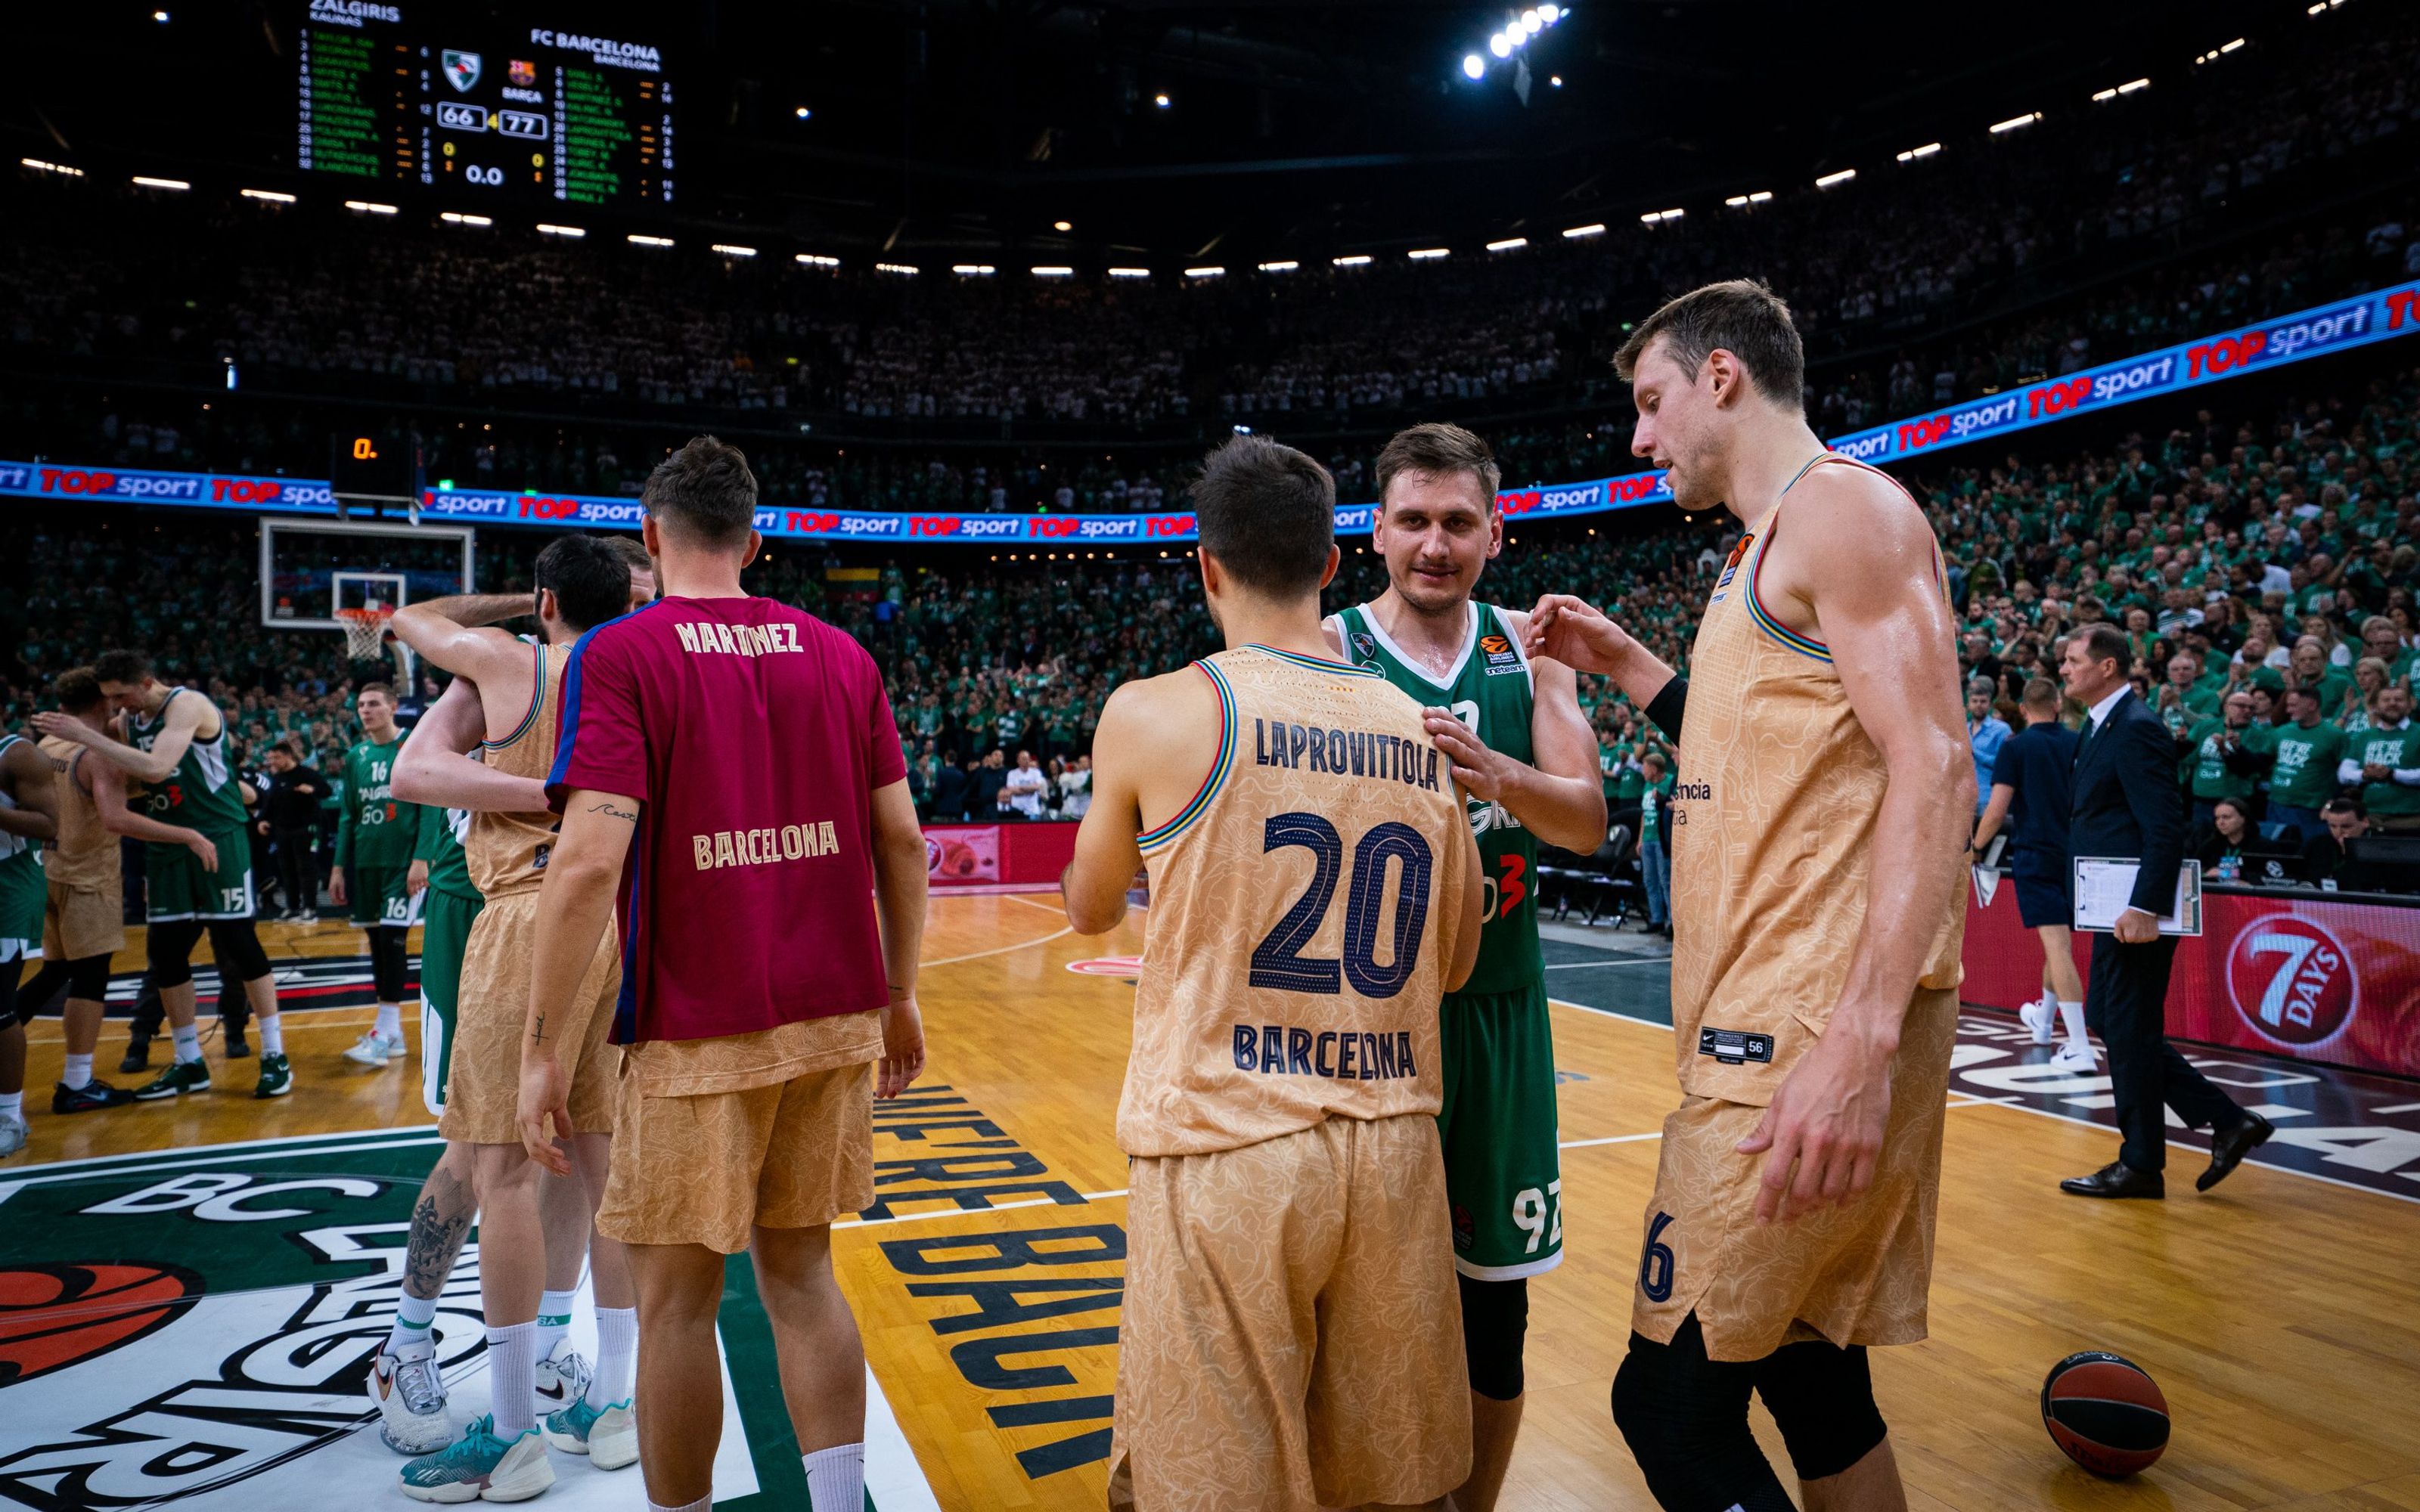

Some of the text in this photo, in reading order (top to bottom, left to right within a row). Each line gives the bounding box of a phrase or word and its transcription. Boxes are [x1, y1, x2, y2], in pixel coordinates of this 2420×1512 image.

[531, 29, 661, 62] FC BARCELONA
[442, 106, 474, 126] 66
[505, 114, 535, 134] 77
[465, 164, 504, 185] 0.0
[2186, 330, 2267, 381] TOP
[2267, 303, 2369, 355] sport
[2027, 356, 2173, 420] TOP sport
[1897, 398, 2018, 453] TOP sport
[40, 468, 116, 496] TOP
[116, 477, 198, 500] sport
[211, 478, 337, 507] TOP spo
[1541, 485, 1600, 512] sport
[1607, 474, 1657, 505] TOP
[435, 494, 507, 515] sport
[517, 496, 646, 522] TOP sport
[1333, 509, 1368, 528] ort
[785, 511, 840, 534] TOP
[840, 516, 901, 536] sport
[908, 516, 1020, 538] TOP sport
[1028, 516, 1137, 539] TOP sport
[1145, 516, 1196, 538] TOP
[674, 622, 805, 658] MARTINEZ
[1255, 718, 1440, 793] LAPROVITTOLA
[371, 761, 388, 782] 16
[692, 820, 840, 871] BARCELONA
[221, 887, 244, 912] 15
[386, 897, 407, 919] 16
[1249, 811, 1433, 999] 20
[2251, 932, 2319, 1027] 7
[2285, 944, 2341, 1029] DAYS
[1233, 1024, 1417, 1080] BARCELONA
[1748, 1040, 1764, 1054] 56
[79, 1173, 379, 1222] BC
[1641, 1210, 1675, 1303] 6
